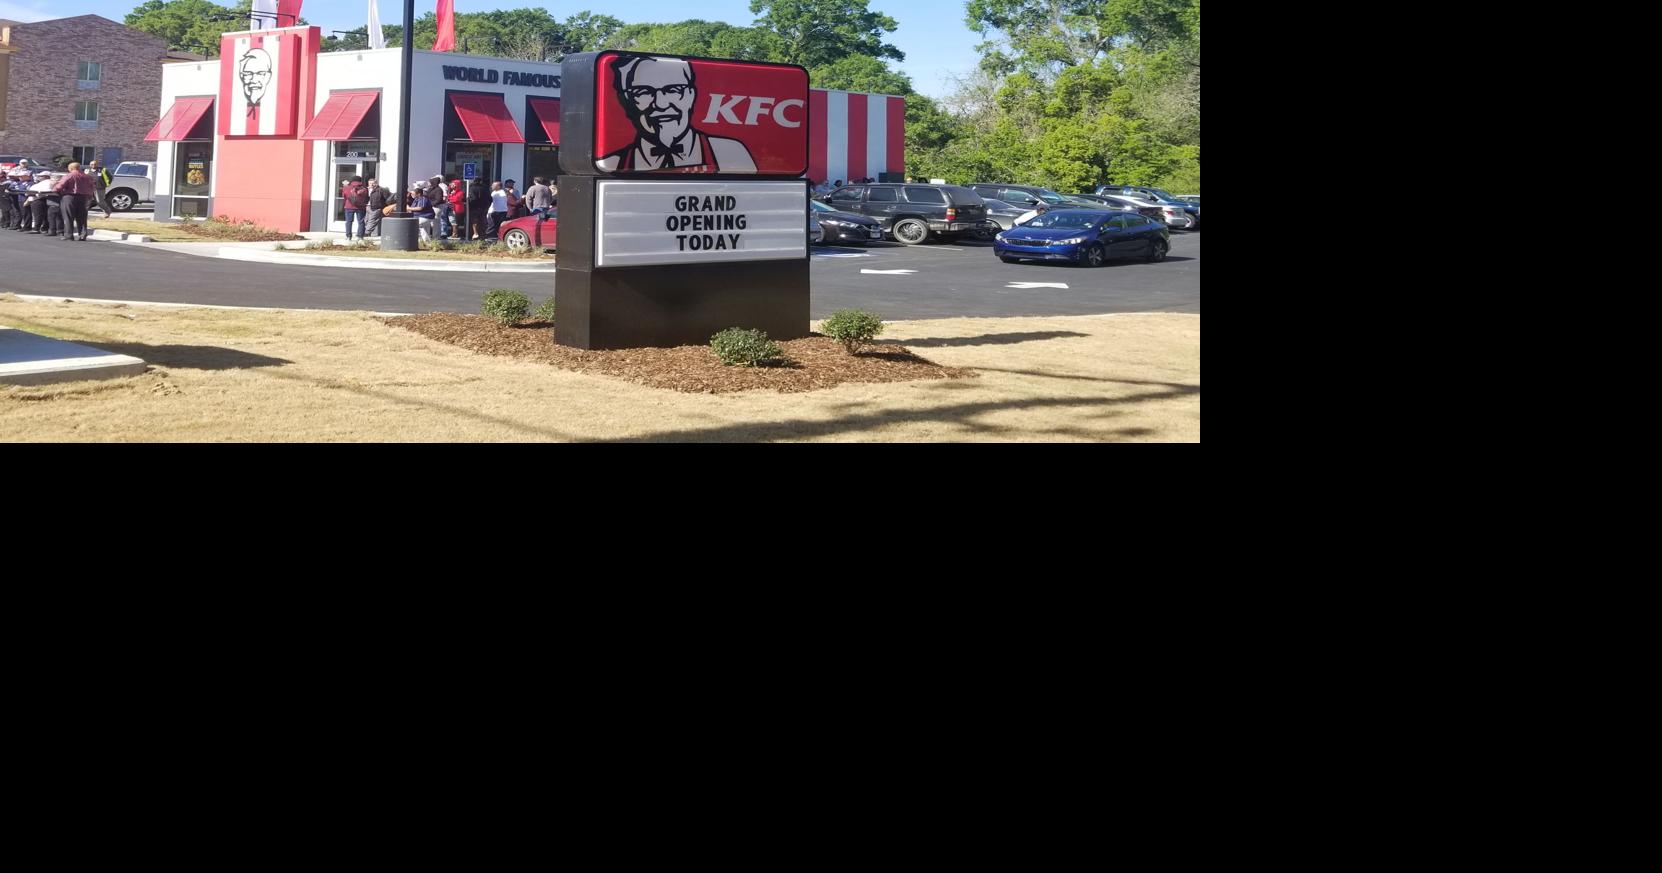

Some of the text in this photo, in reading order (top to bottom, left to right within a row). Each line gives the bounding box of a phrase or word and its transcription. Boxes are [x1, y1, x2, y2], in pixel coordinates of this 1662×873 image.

[442, 65, 560, 88] WORLD FAMOUS
[702, 93, 804, 128] KFC
[675, 195, 736, 212] GRAND
[666, 214, 746, 231] OPENING
[676, 234, 740, 251] TODAY
